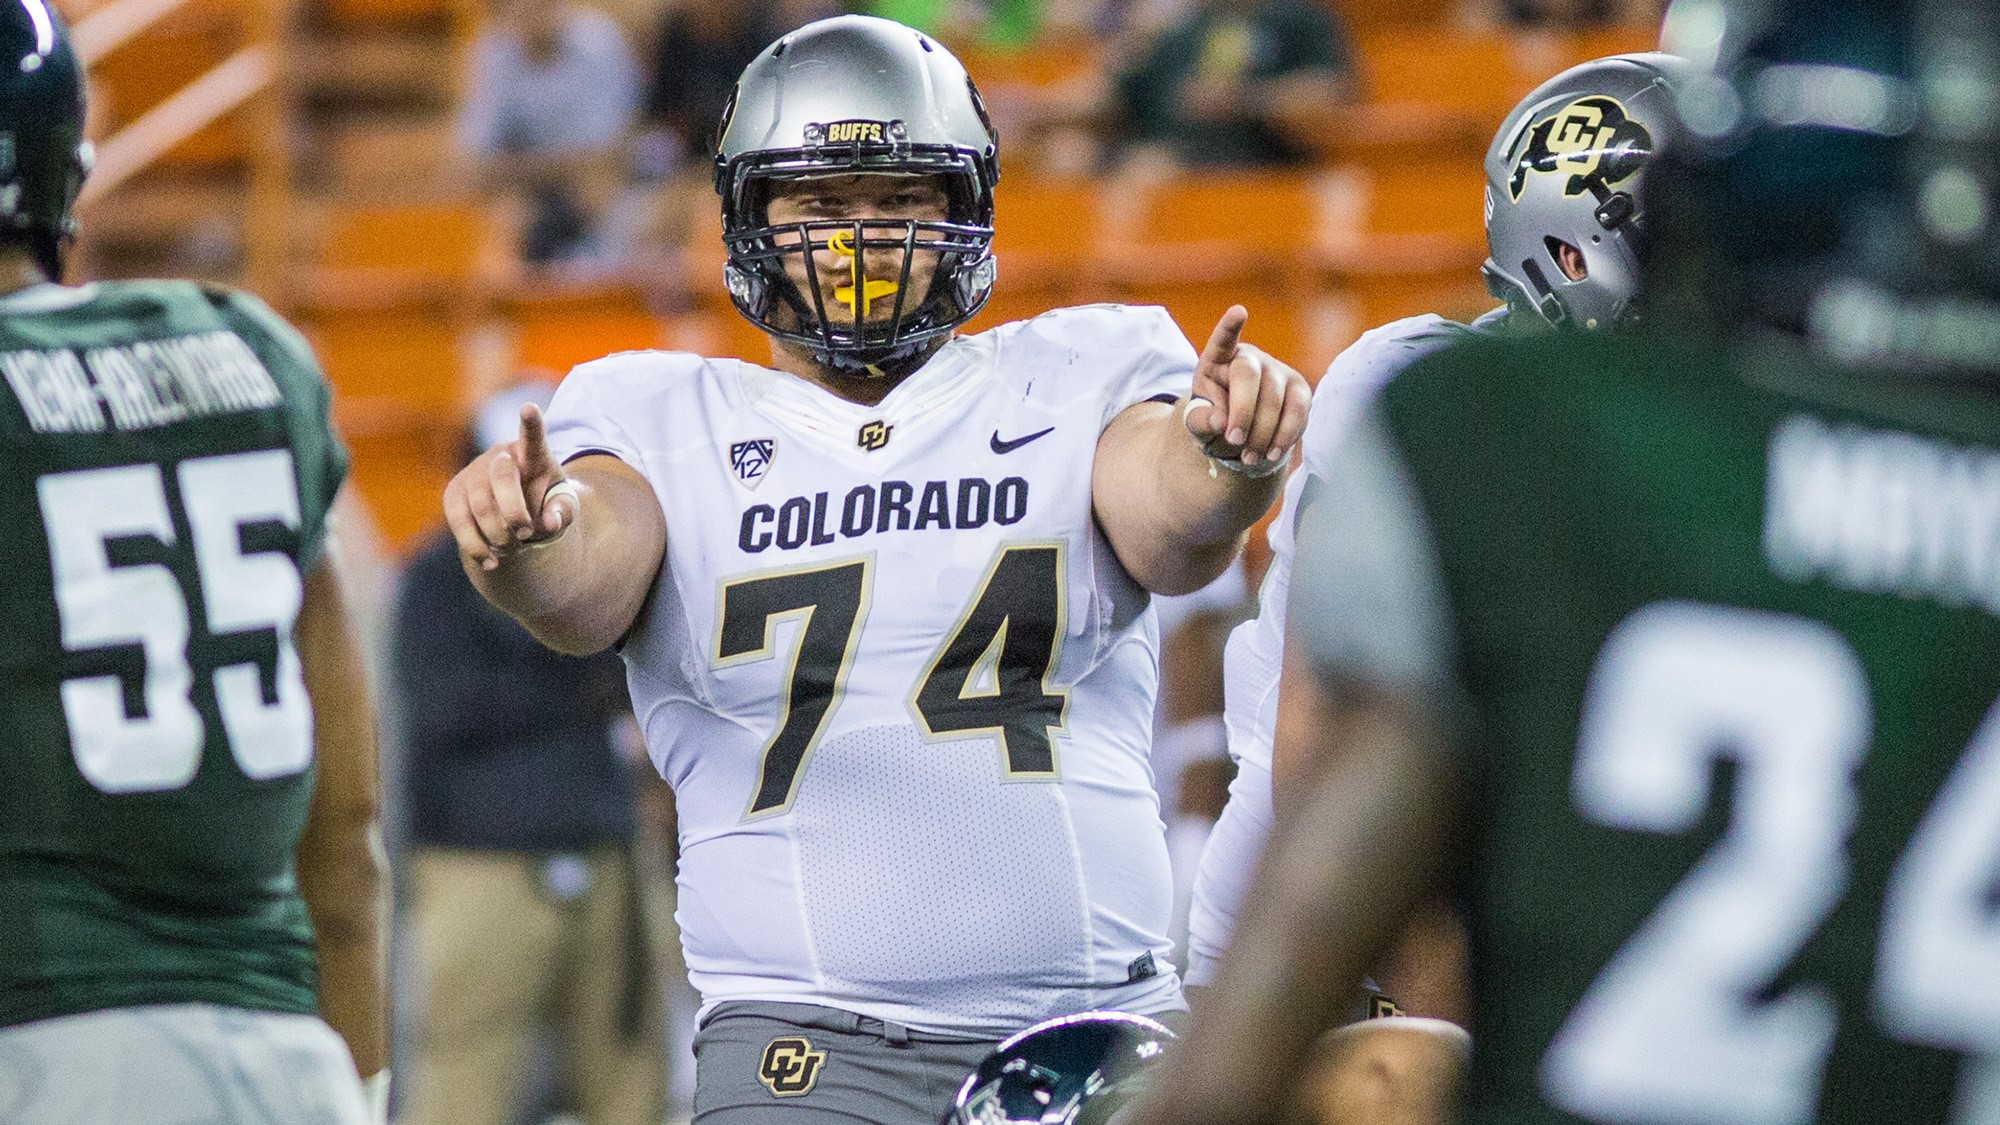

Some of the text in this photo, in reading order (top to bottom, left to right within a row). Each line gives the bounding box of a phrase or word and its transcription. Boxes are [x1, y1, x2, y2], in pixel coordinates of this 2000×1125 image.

[828, 122, 881, 142] BUFFS
[730, 439, 774, 470] PAC
[740, 458, 763, 479] 12
[738, 476, 1029, 554] COLORADO
[36, 449, 315, 795] 55
[710, 538, 1072, 824] 74
[759, 1036, 826, 1095] CU
